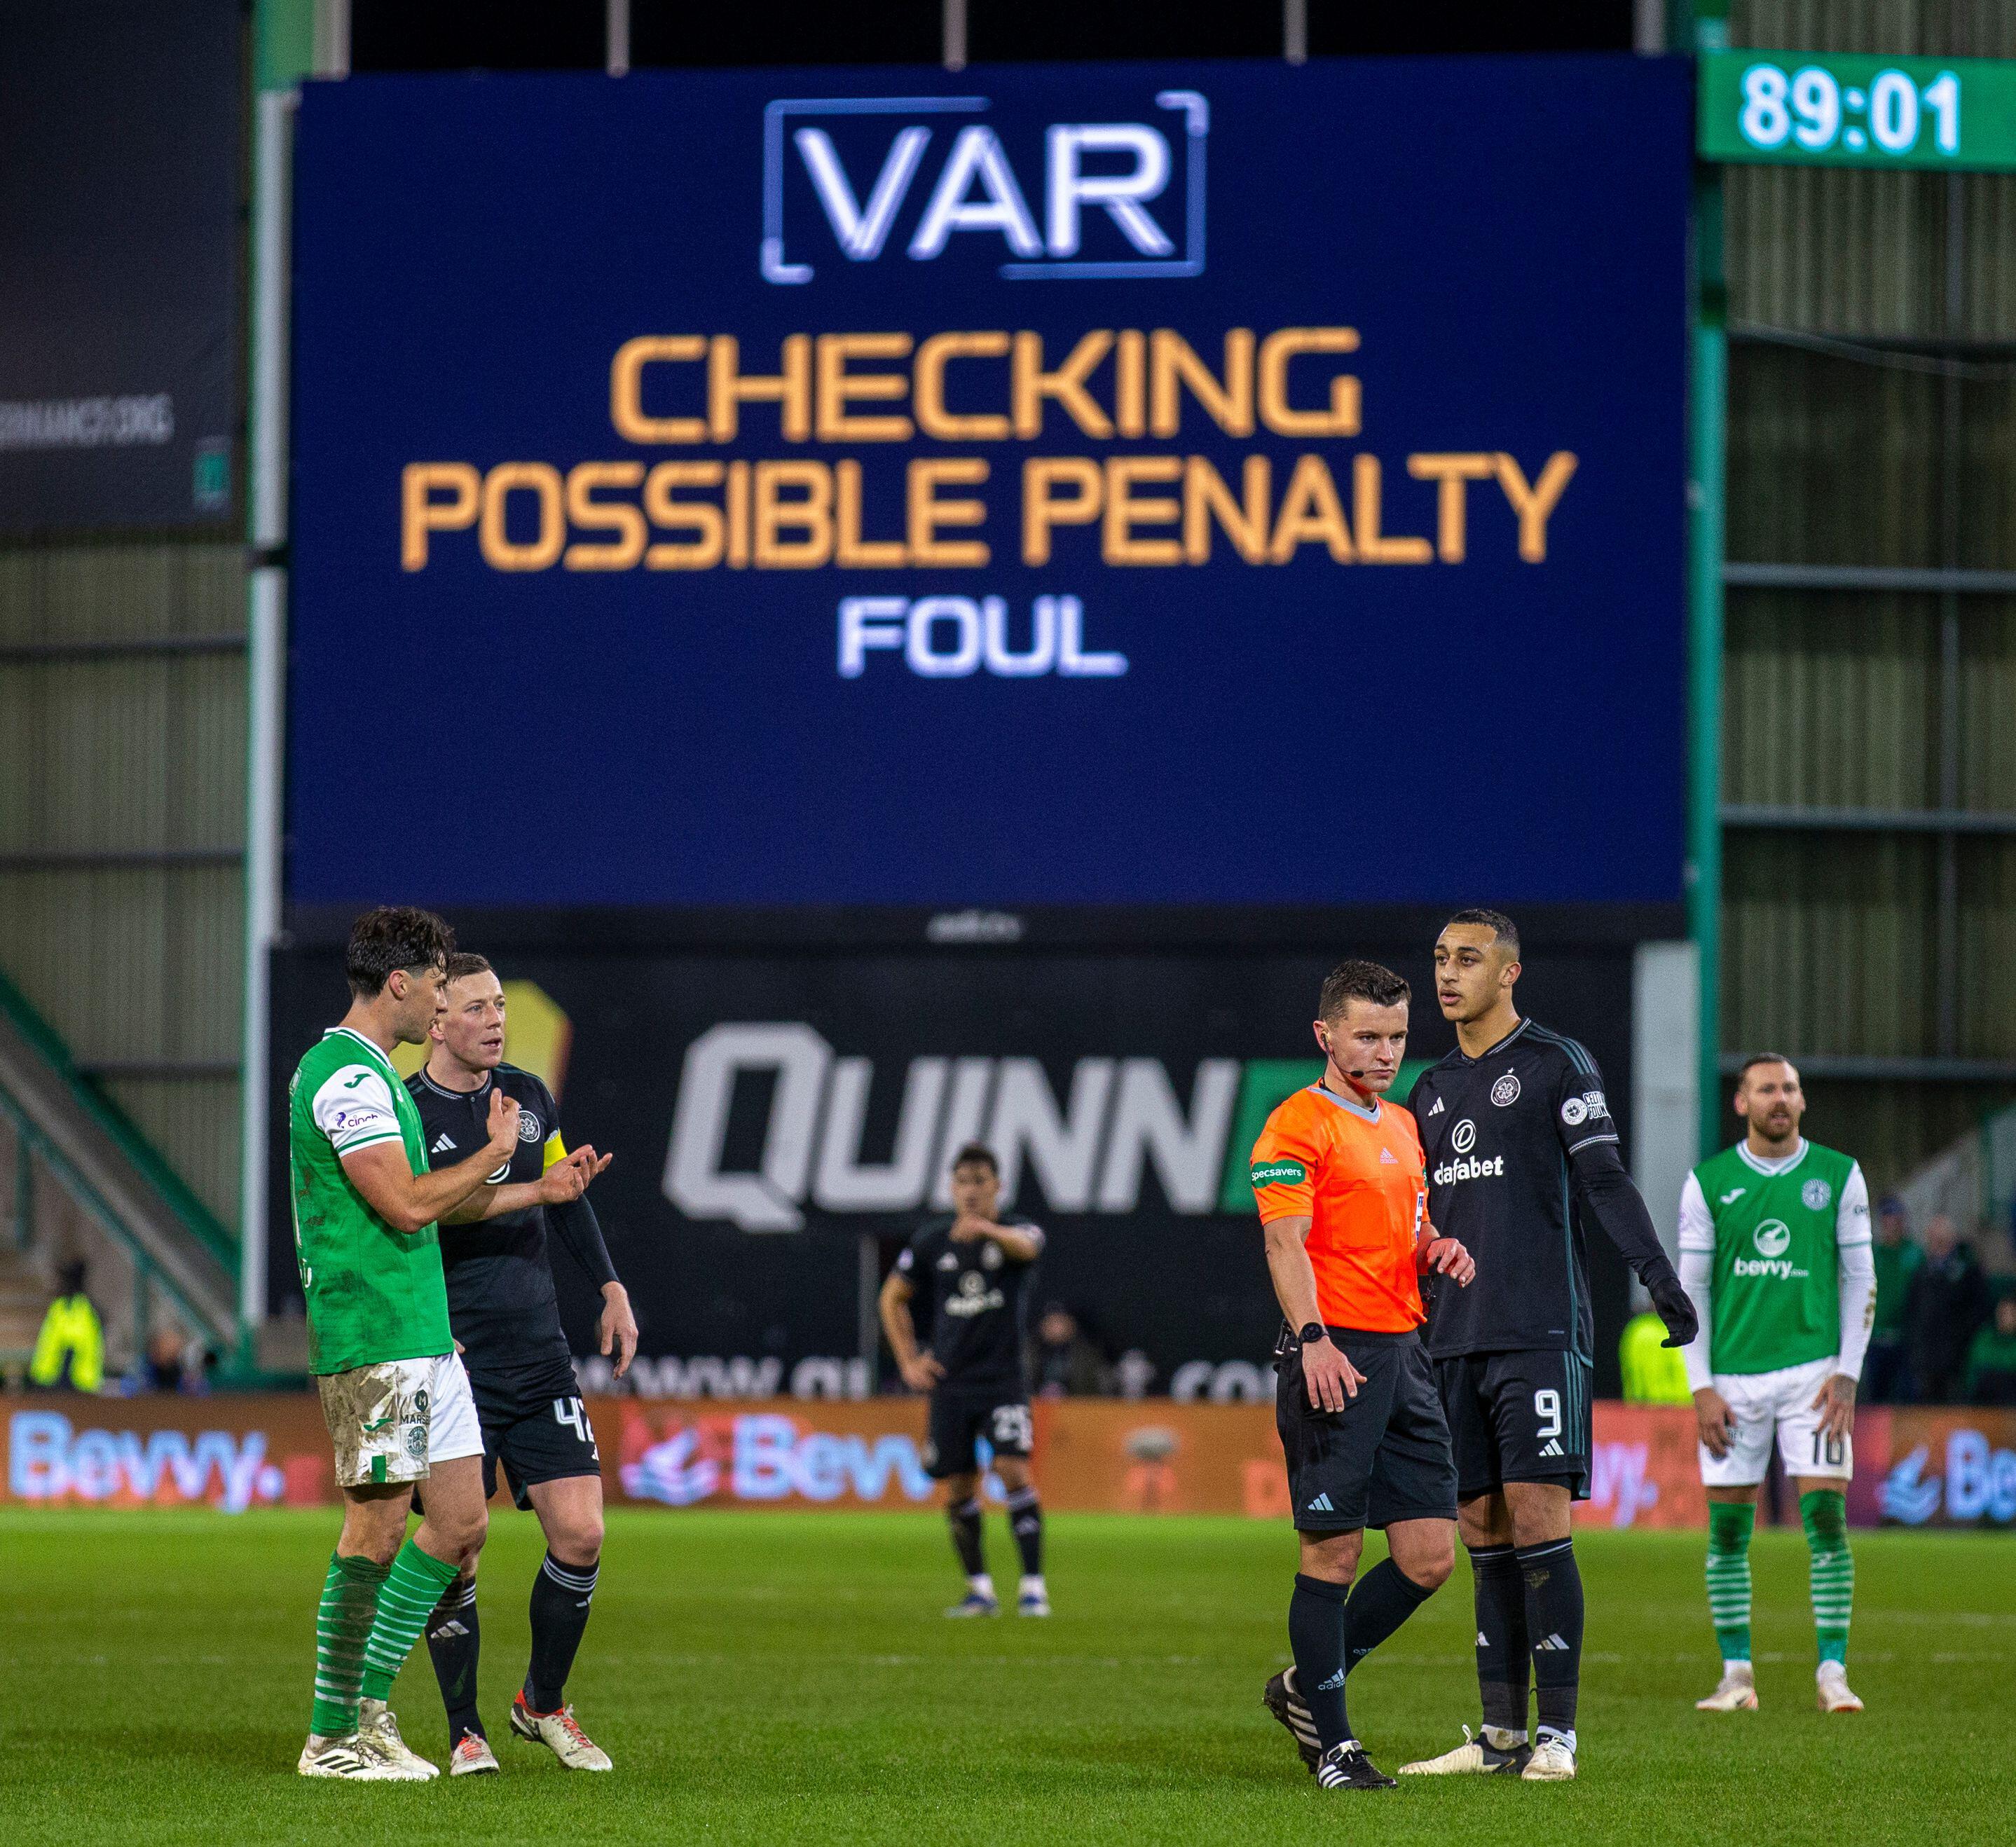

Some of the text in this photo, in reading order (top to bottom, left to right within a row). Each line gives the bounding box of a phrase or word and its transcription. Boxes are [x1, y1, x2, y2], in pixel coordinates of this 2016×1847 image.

[1739, 63, 1961, 157] 89:01
[795, 125, 1177, 260] VAR
[610, 327, 1362, 444] CHECKING
[402, 451, 1579, 572] POSSIBLE PENALTY
[837, 594, 1129, 679] FOUL
[664, 1022, 1242, 1233] QUINN
[1434, 1155, 1504, 1186] dafabet
[1252, 1168, 1302, 1181] specsavers
[1535, 1389, 1562, 1438] 9
[1811, 1429, 1845, 1465] 10
